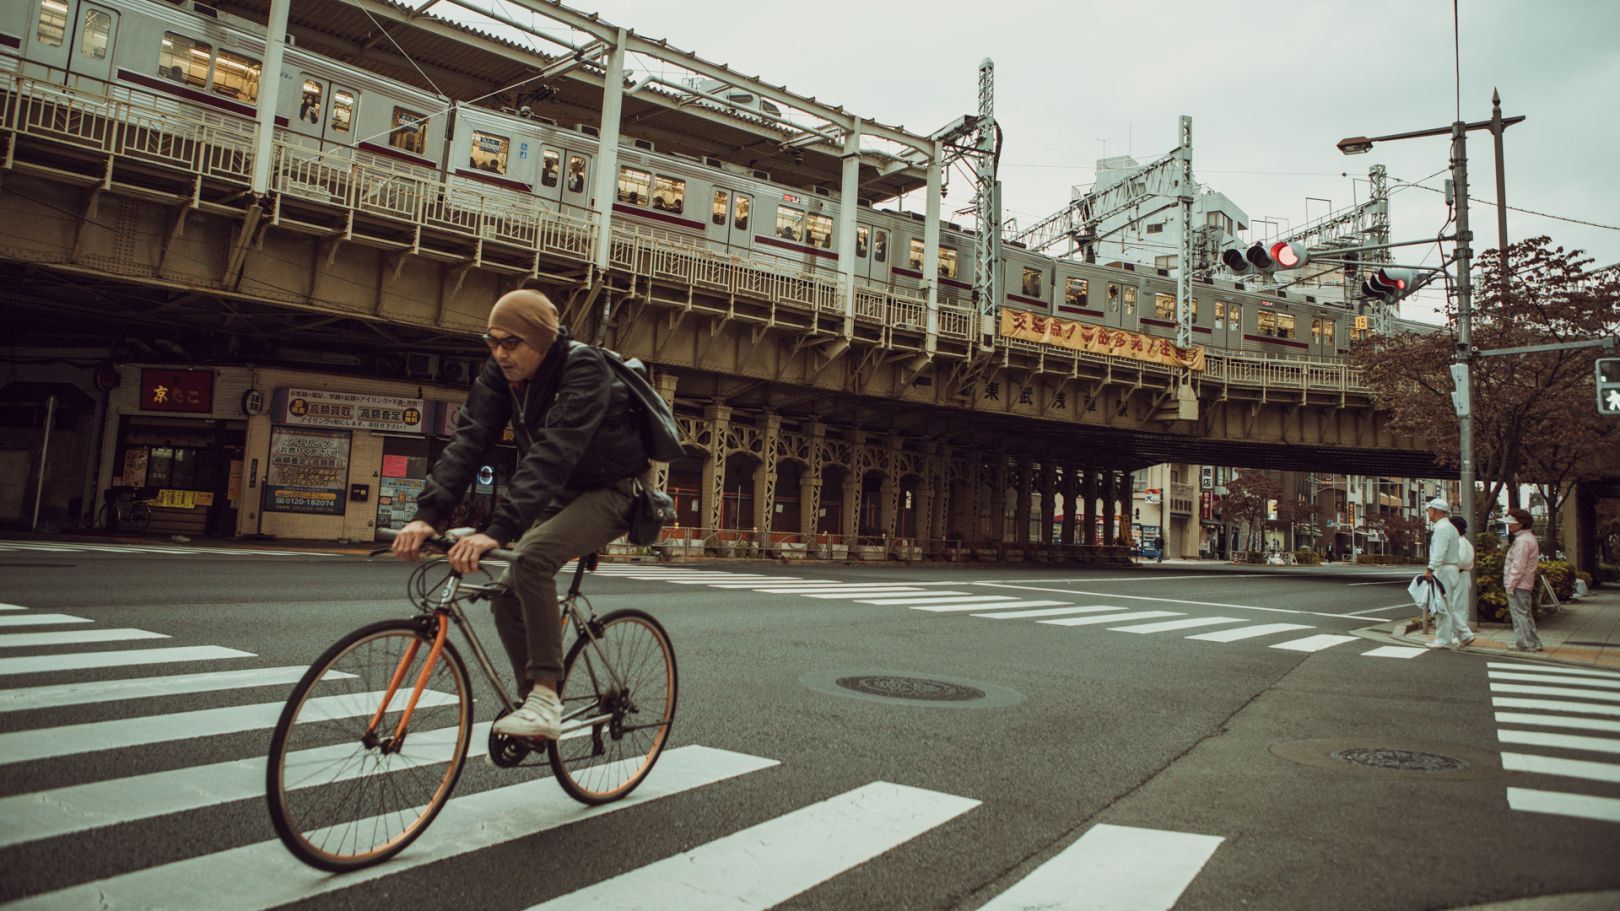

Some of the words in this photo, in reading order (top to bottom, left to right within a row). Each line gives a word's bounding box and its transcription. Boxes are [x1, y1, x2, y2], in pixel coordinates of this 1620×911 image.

[1357, 318, 1366, 328] 15
[153, 385, 200, 404] 京たこ
[309, 404, 351, 416] 高額買取
[360, 408, 401, 421] 高額査定
[1203, 468, 1211, 487] 商店
[286, 498, 335, 507] 0120-182074
